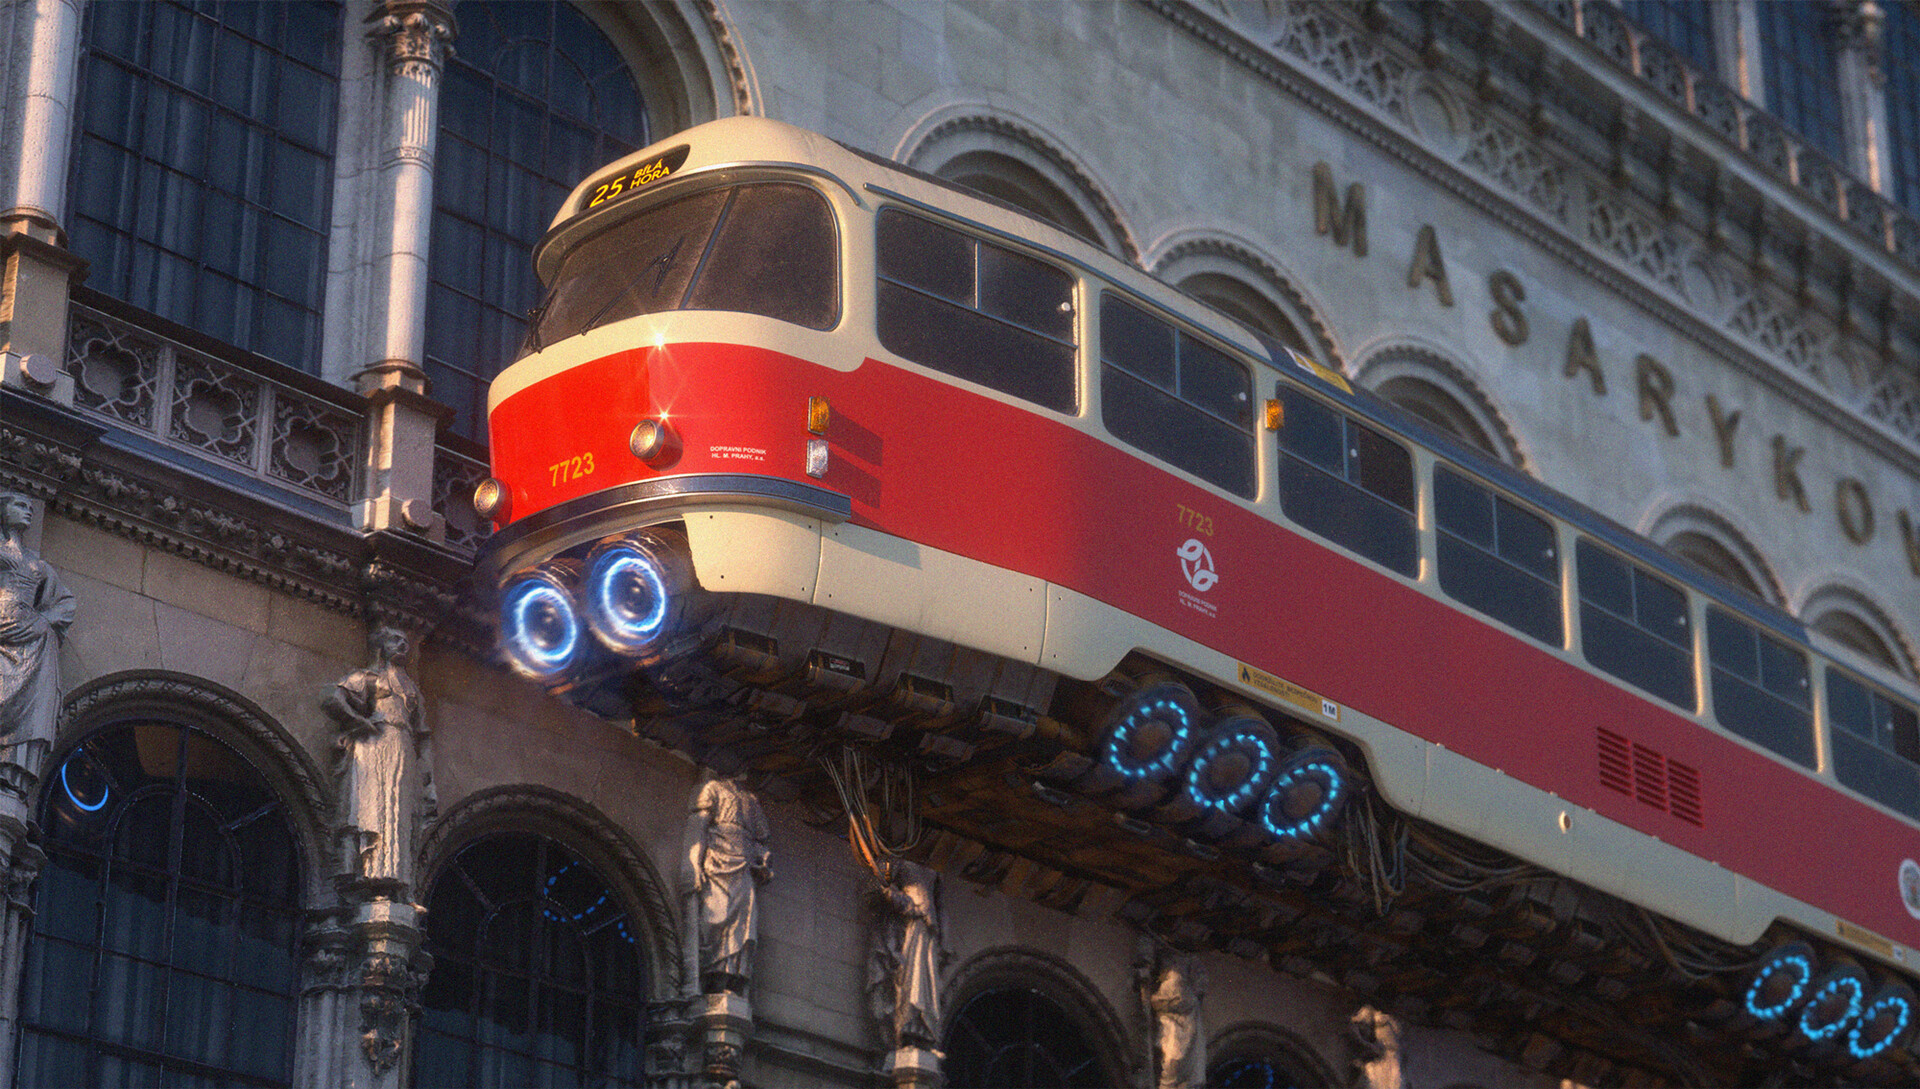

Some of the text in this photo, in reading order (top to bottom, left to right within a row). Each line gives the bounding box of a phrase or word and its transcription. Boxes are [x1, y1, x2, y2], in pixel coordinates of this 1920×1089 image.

[629, 166, 670, 190] HORA
[633, 158, 663, 179] BÍLÁ
[589, 176, 627, 208] 25
[743, 447, 767, 455] PODNIK
[549, 451, 595, 487] 7723
[1177, 503, 1214, 536] 7723
